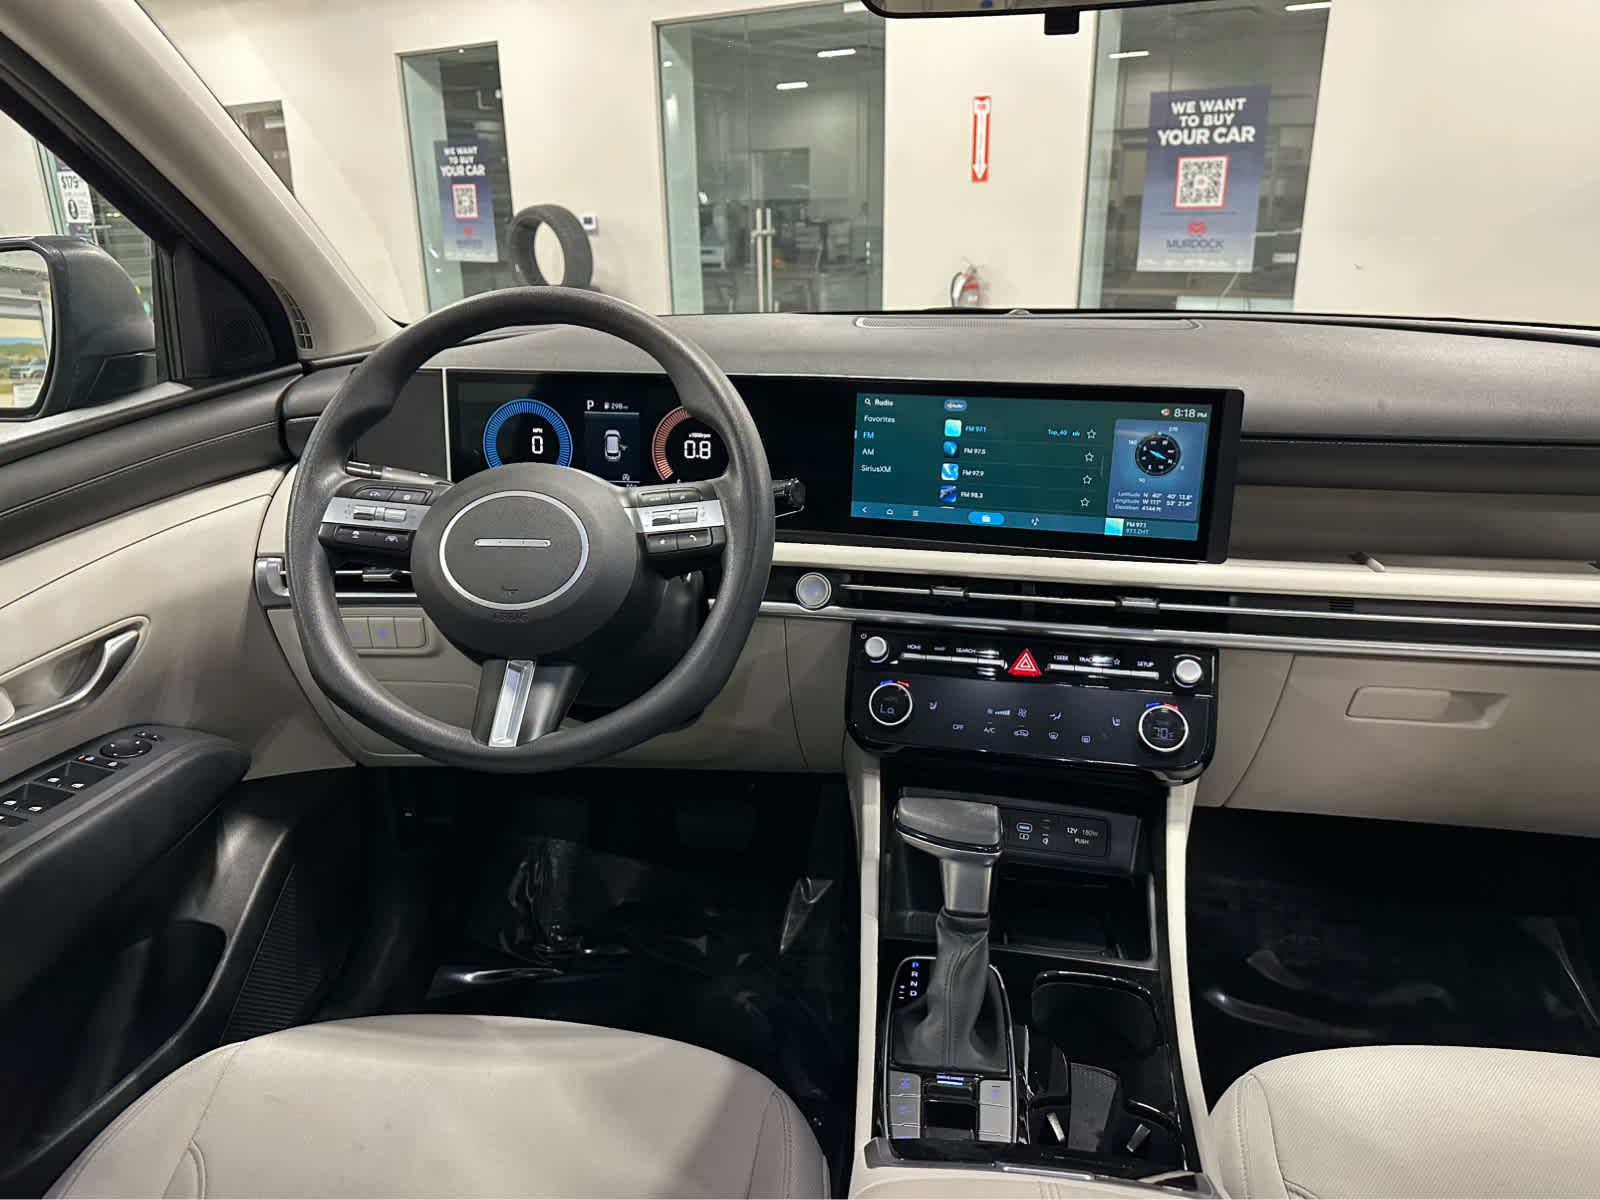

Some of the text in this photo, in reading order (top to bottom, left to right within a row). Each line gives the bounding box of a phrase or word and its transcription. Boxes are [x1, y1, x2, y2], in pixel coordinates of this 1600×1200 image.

[1171, 98, 1247, 114] WE WANT
[1180, 113, 1235, 127] TO BUY
[1157, 126, 1255, 146] YOUR CAR
[444, 146, 477, 155] WE WANT
[449, 156, 475, 164] TO BUY
[440, 164, 486, 176] YOUR CAR
[1166, 239, 1224, 249] MURDOCK
[587, 400, 594, 410] P
[1174, 408, 1196, 418] 8:18
[864, 415, 896, 423] Favorites
[863, 431, 875, 439] FM
[532, 436, 543, 454] 0
[684, 440, 711, 460] 0.8
[862, 448, 875, 456] AM
[860, 464, 891, 473] SiriusXM
